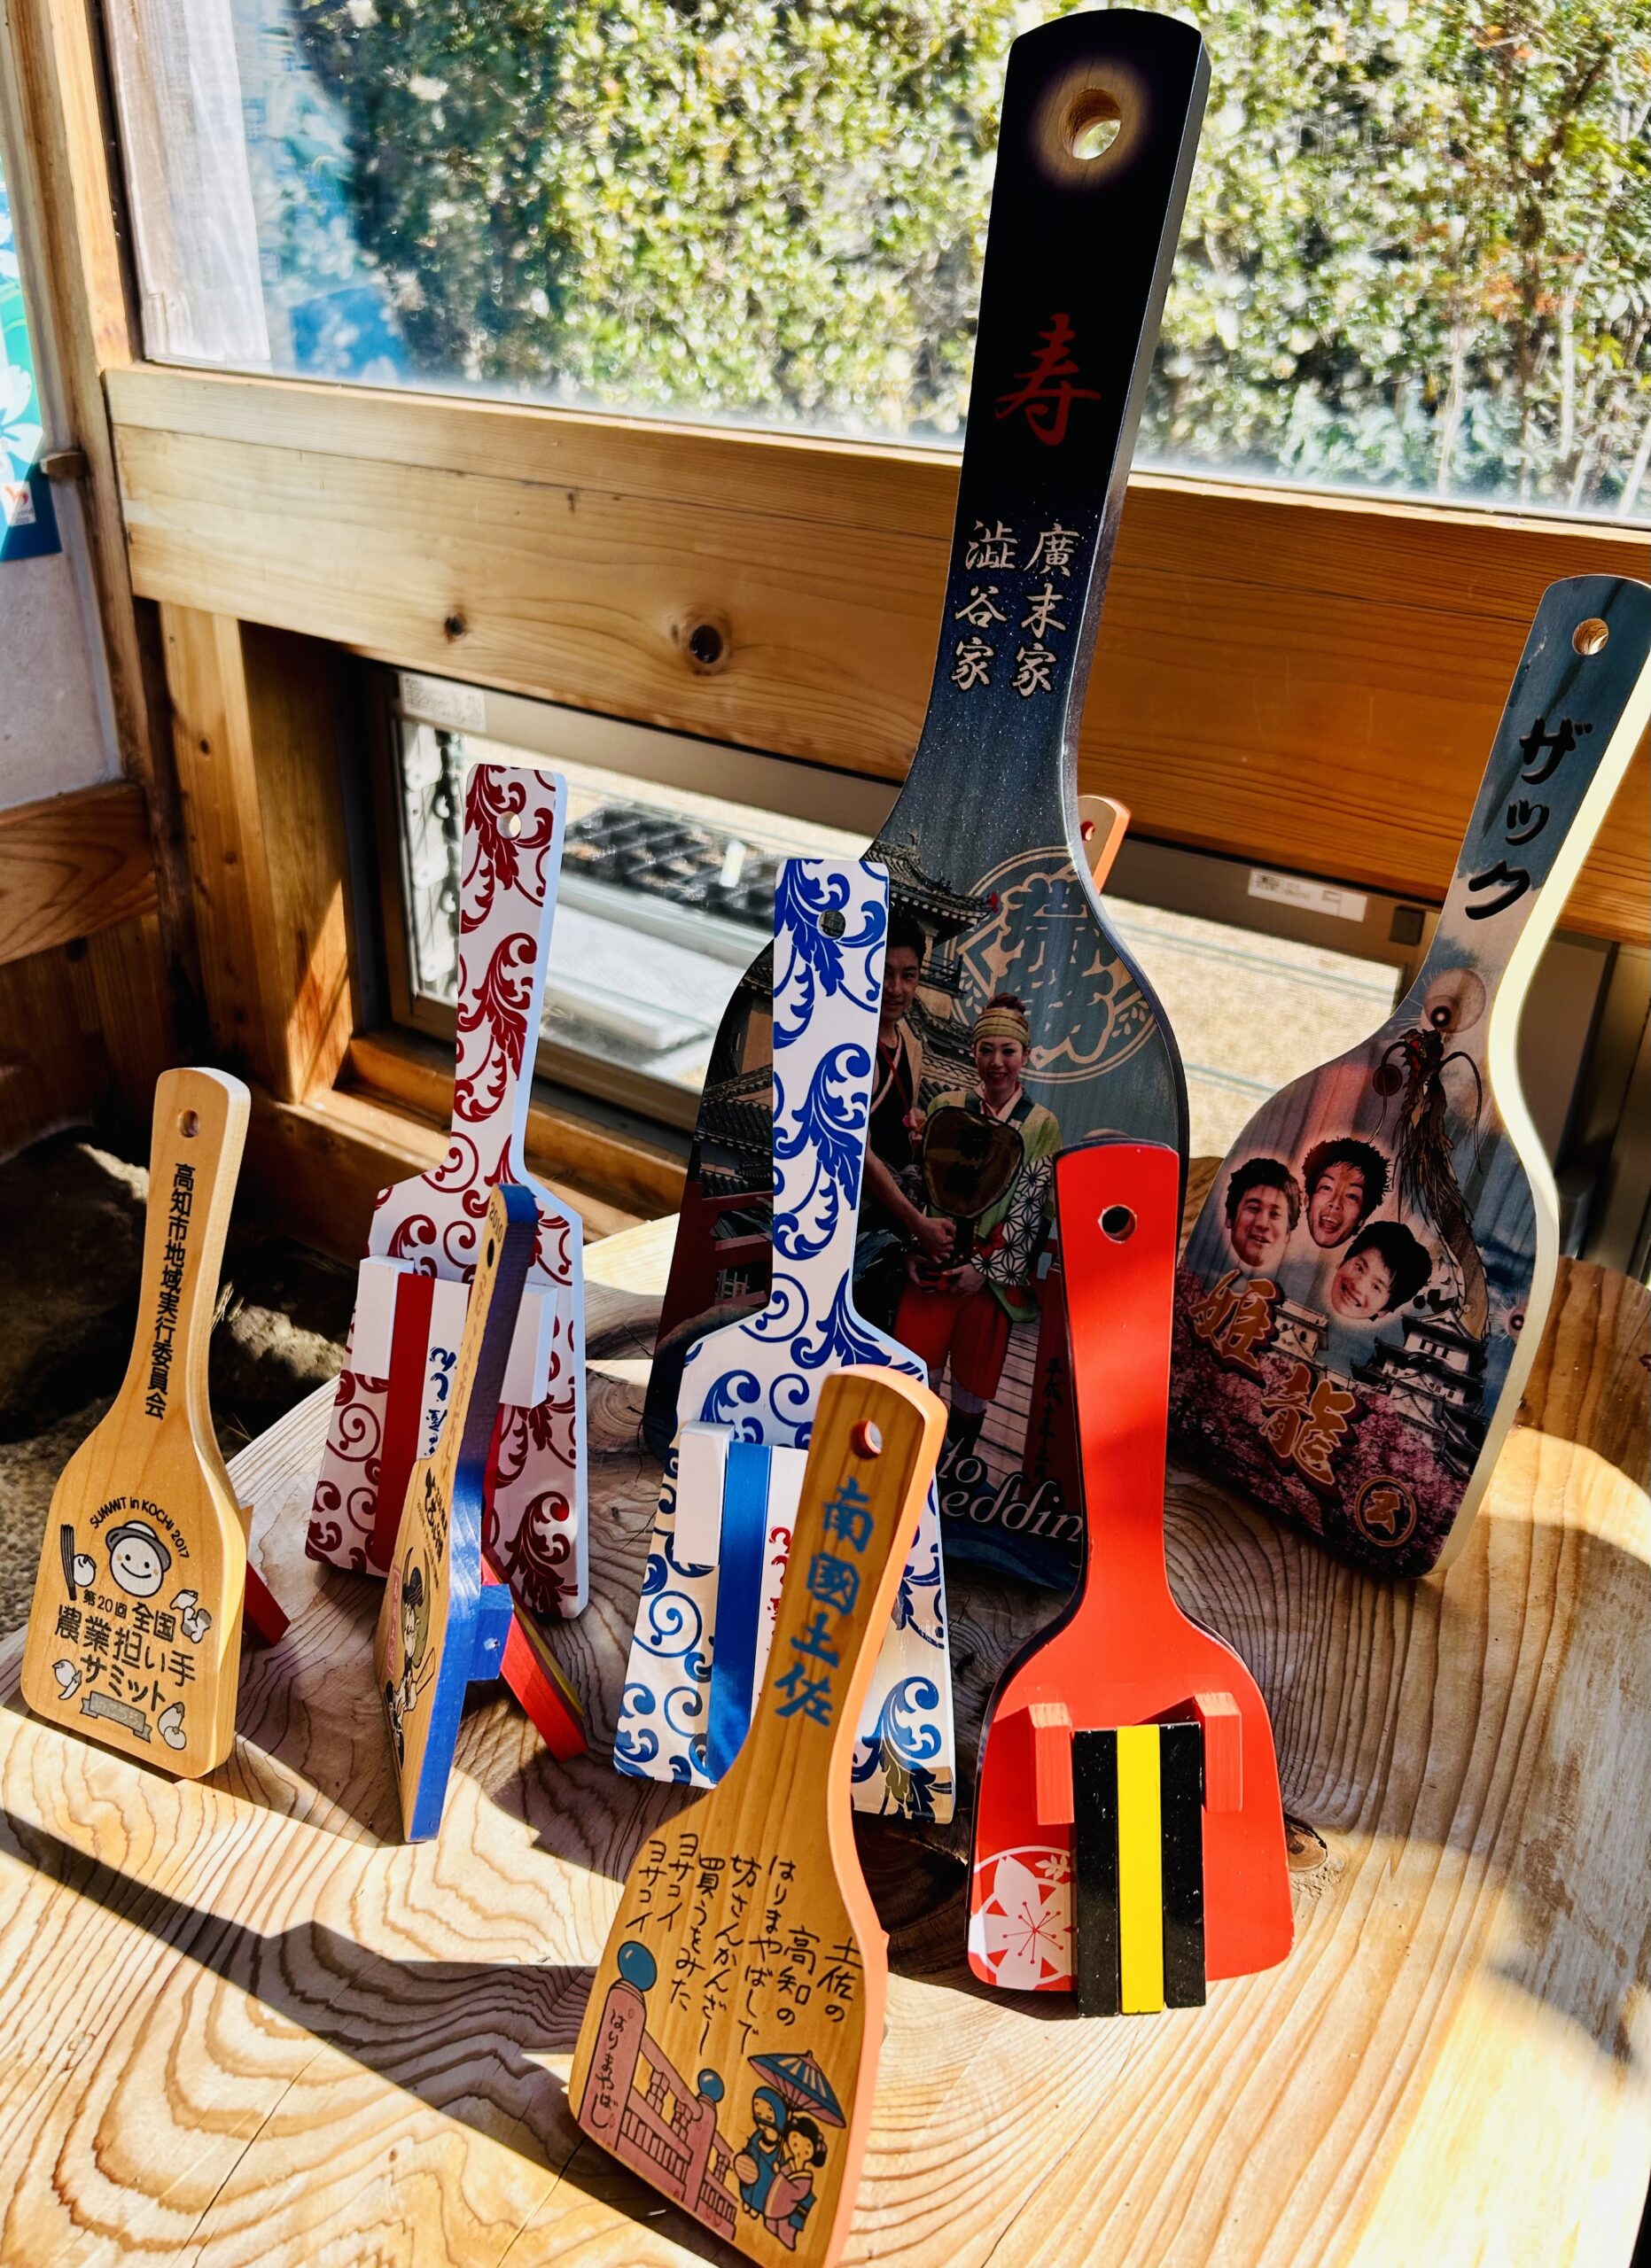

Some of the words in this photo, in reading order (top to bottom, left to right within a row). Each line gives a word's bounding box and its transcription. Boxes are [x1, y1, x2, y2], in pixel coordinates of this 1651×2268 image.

[994, 313, 1102, 447] 寿
[1012, 524, 1080, 698] 廣末家
[1464, 716, 1593, 921] ザック
[144, 1162, 197, 1420] 高知市地域実行委員会
[90, 1496, 127, 1529] SUMMIT
[129, 1496, 140, 1510] in
[141, 1499, 175, 1532] KOCHI
[170, 1529, 191, 1559] 2017
[941, 1473, 1084, 1569] eddin
[54, 1604, 197, 1687] 農業担い手
[775, 1477, 876, 1727] 南國土佐
[80, 1654, 167, 1712] サミット
[626, 1840, 667, 1933] ヨサコイ
[657, 1833, 698, 1932] ヨサコイ
[670, 1852, 726, 2012] 買うをみた
[738, 1854, 797, 2055] はりまやばしで
[776, 1925, 821, 2026] 高知の
[816, 1937, 863, 2023] 土佐の
